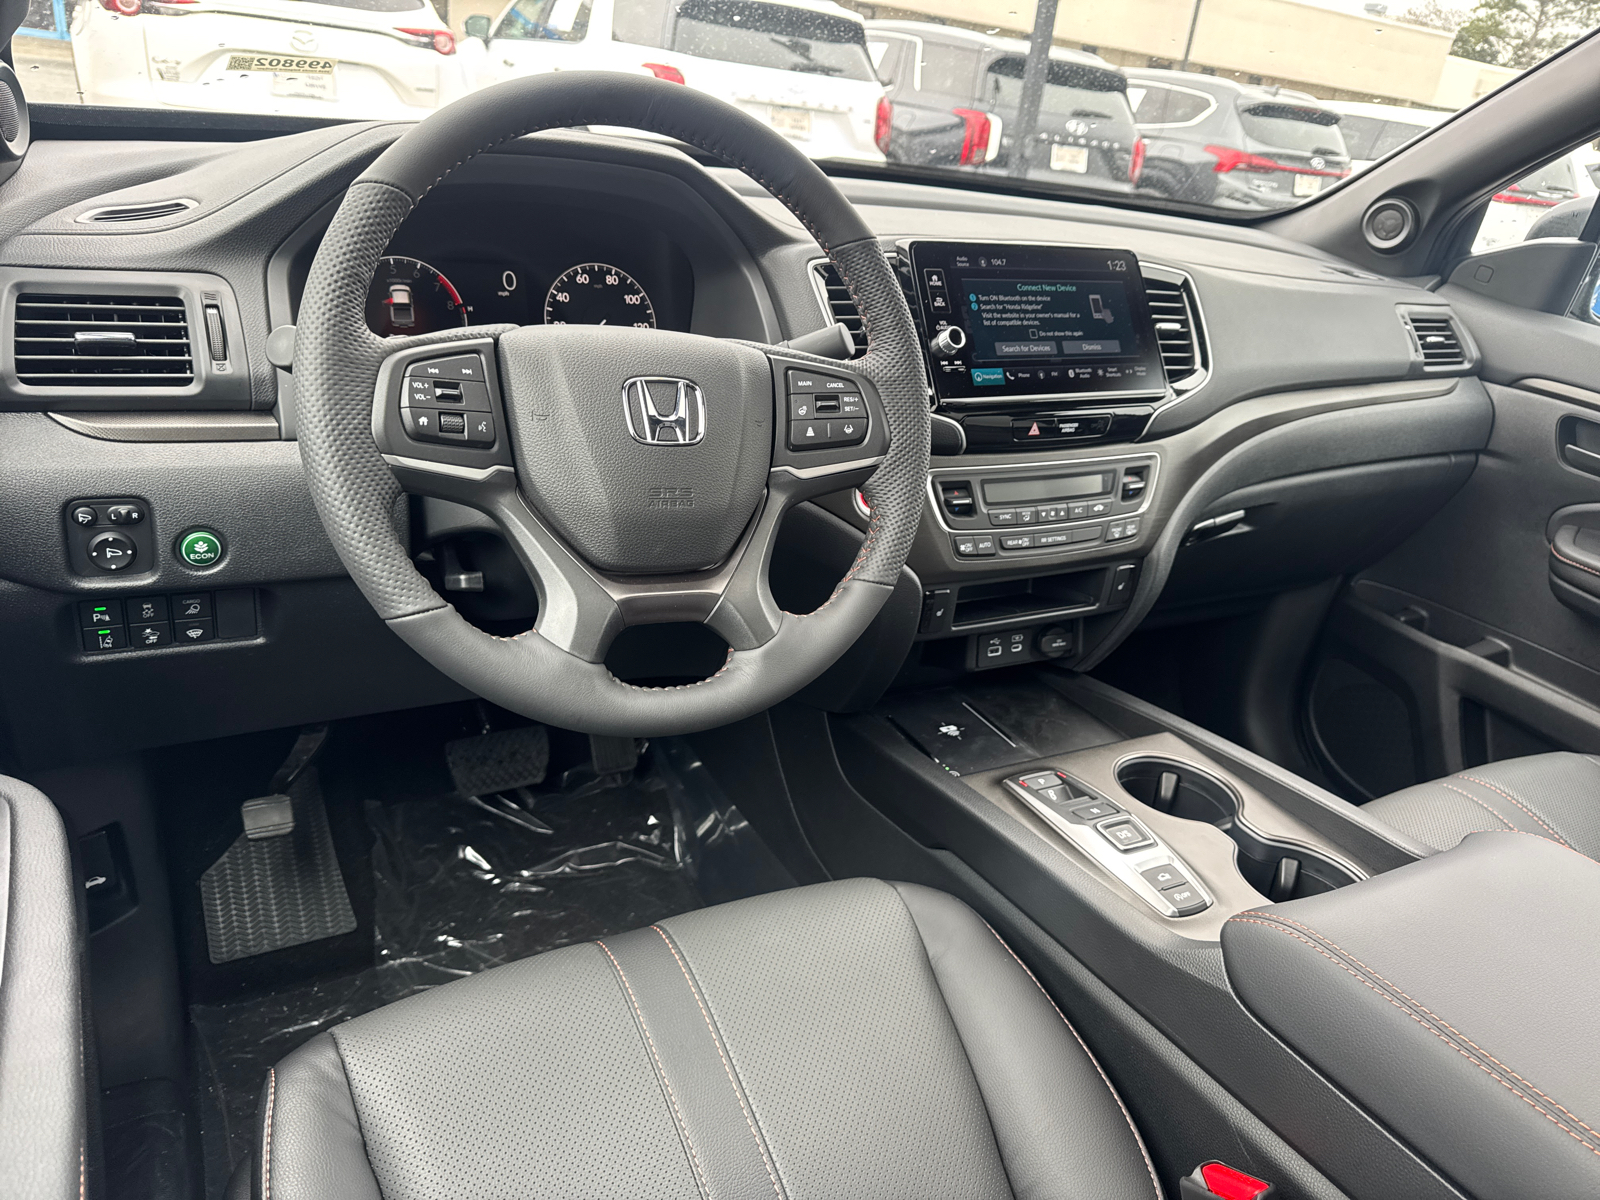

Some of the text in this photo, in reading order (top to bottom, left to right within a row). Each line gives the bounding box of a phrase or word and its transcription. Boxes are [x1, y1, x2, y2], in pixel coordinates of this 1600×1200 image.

[991, 258, 1007, 266] 104.7
[1106, 260, 1127, 271] 1:23
[390, 265, 397, 274] 5
[413, 270, 421, 279] 6
[575, 274, 590, 284] 60
[605, 275, 619, 285] 80
[433, 282, 440, 292] 7
[1016, 283, 1041, 292] Connect
[1056, 284, 1077, 292] Device
[556, 292, 570, 303] 40
[623, 294, 641, 305] 100
[447, 301, 454, 310] 8
[1002, 345, 1020, 353] Search
[1029, 344, 1051, 352] Devices
[1082, 343, 1102, 351] Dismiss
[648, 487, 694, 499] SRS
[649, 500, 695, 509] AIRBAG
[1047, 535, 1066, 543] SETTINGS
[189, 552, 215, 560] ECON
